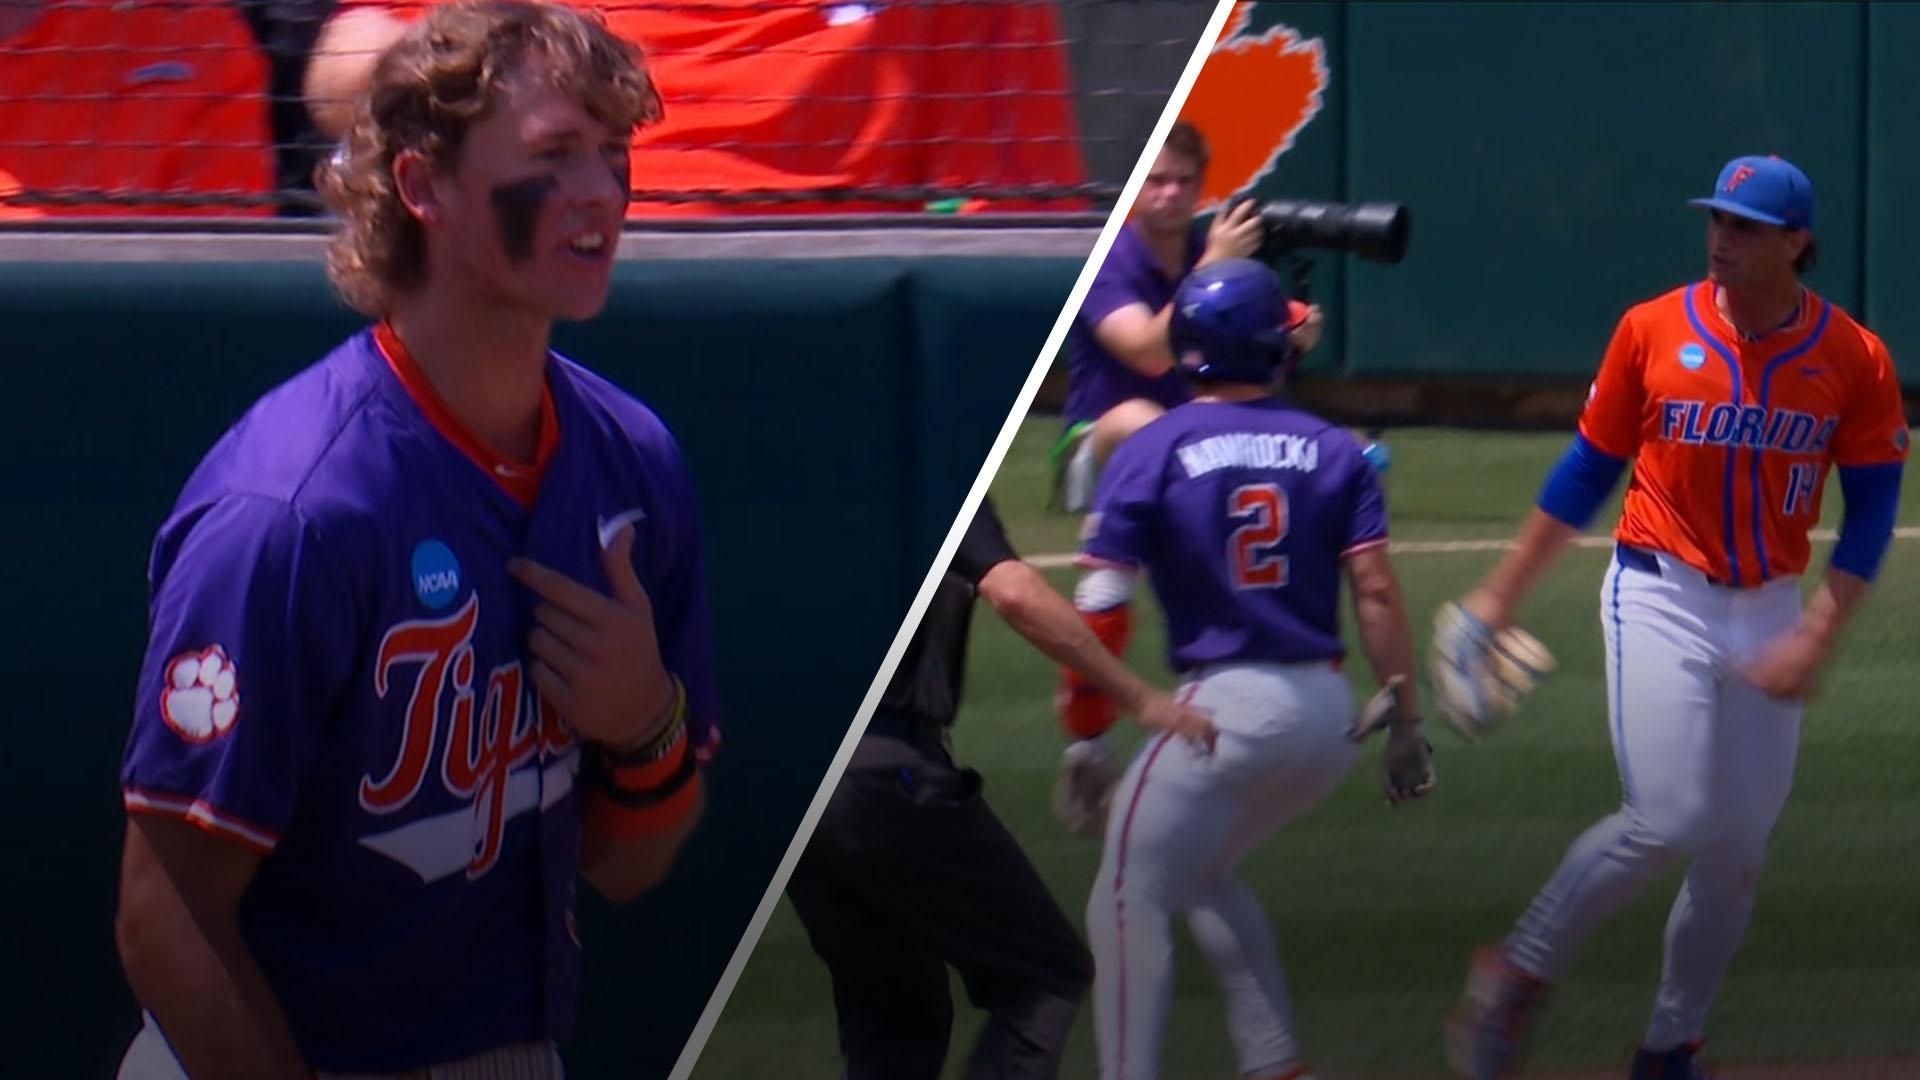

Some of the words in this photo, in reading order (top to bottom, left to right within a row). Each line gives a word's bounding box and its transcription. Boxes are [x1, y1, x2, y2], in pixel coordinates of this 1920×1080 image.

[1723, 164, 1756, 193] F
[1661, 400, 1840, 452] FLORIDA
[1227, 483, 1290, 590] 2
[418, 568, 459, 596] NCAA
